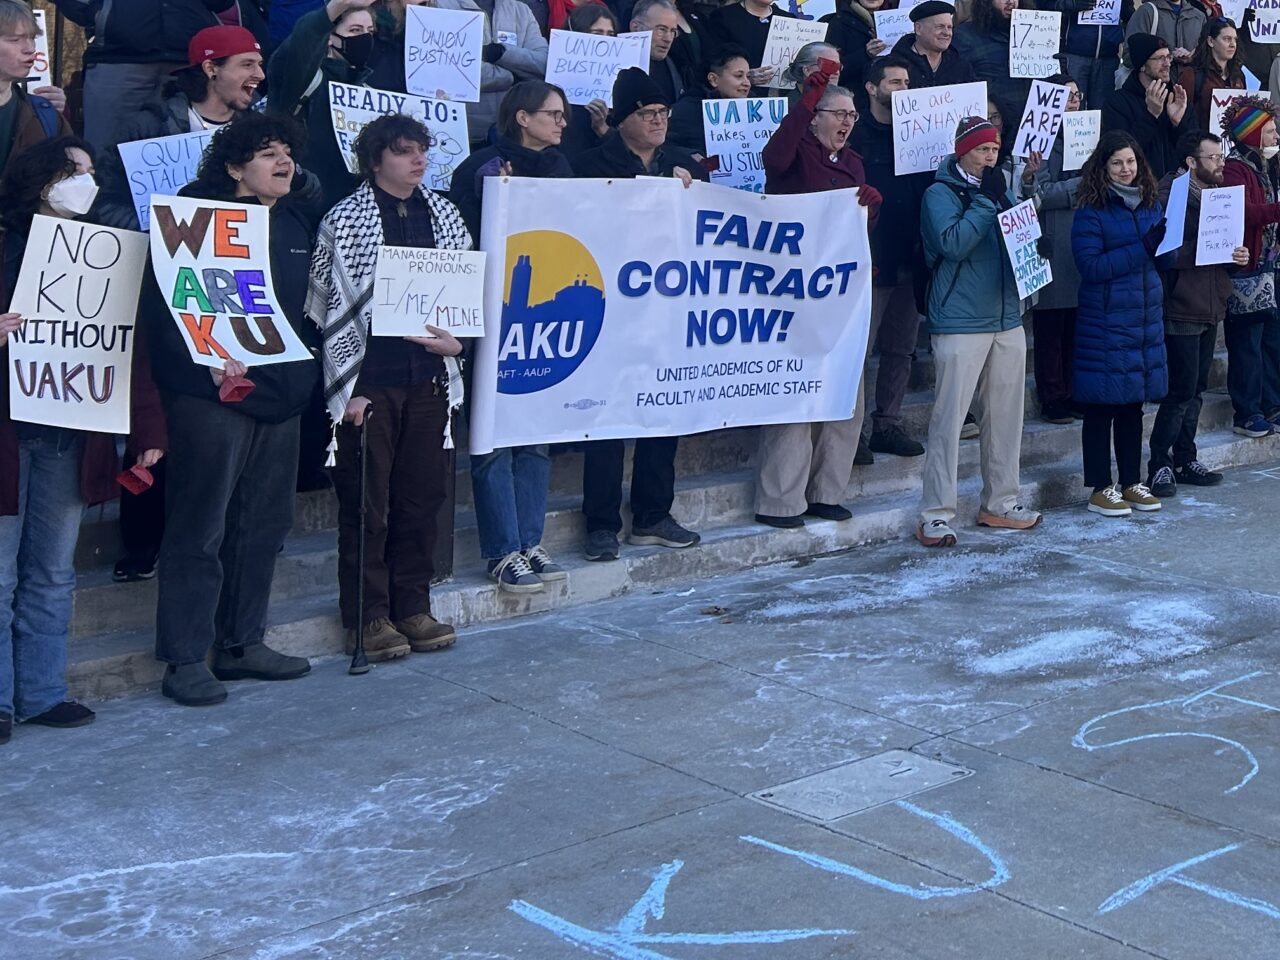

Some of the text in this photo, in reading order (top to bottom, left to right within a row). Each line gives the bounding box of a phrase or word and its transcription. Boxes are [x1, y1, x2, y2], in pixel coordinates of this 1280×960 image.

[422, 28, 467, 49] UNION
[565, 37, 624, 58] UNION
[1011, 23, 1033, 48] 17
[408, 46, 476, 68] BUSTING
[554, 58, 622, 77] BUSTING
[331, 84, 406, 114] READY
[421, 100, 458, 122] TO:
[895, 91, 954, 116] We are
[1036, 85, 1064, 109] WE
[705, 100, 784, 126] UAKU
[1021, 109, 1061, 136] ARE
[710, 129, 774, 142] takes car
[1023, 133, 1049, 154] KU
[141, 135, 210, 166] QUIT
[153, 205, 250, 259] WE
[696, 210, 805, 255] FAIR
[1001, 204, 1037, 235] SANTA
[48, 224, 121, 269] NO
[382, 248, 464, 261] MANAGEMENT
[1015, 240, 1037, 263] FAI
[409, 261, 477, 274] PRONOUNS:
[617, 260, 858, 299] CONTRACT
[37, 271, 110, 319] KU
[172, 266, 275, 316] ARE
[12, 319, 133, 352] WITHOUT
[179, 313, 286, 360] KU
[686, 308, 795, 348] NOW!
[14, 359, 115, 404] UAKU
[497, 370, 517, 379] AFT
[523, 367, 551, 377] AAUP
[656, 359, 803, 382] UNITED ACADEMICS OF KU
[636, 380, 822, 406] FACULTY AND ACADEMIC STAFF
